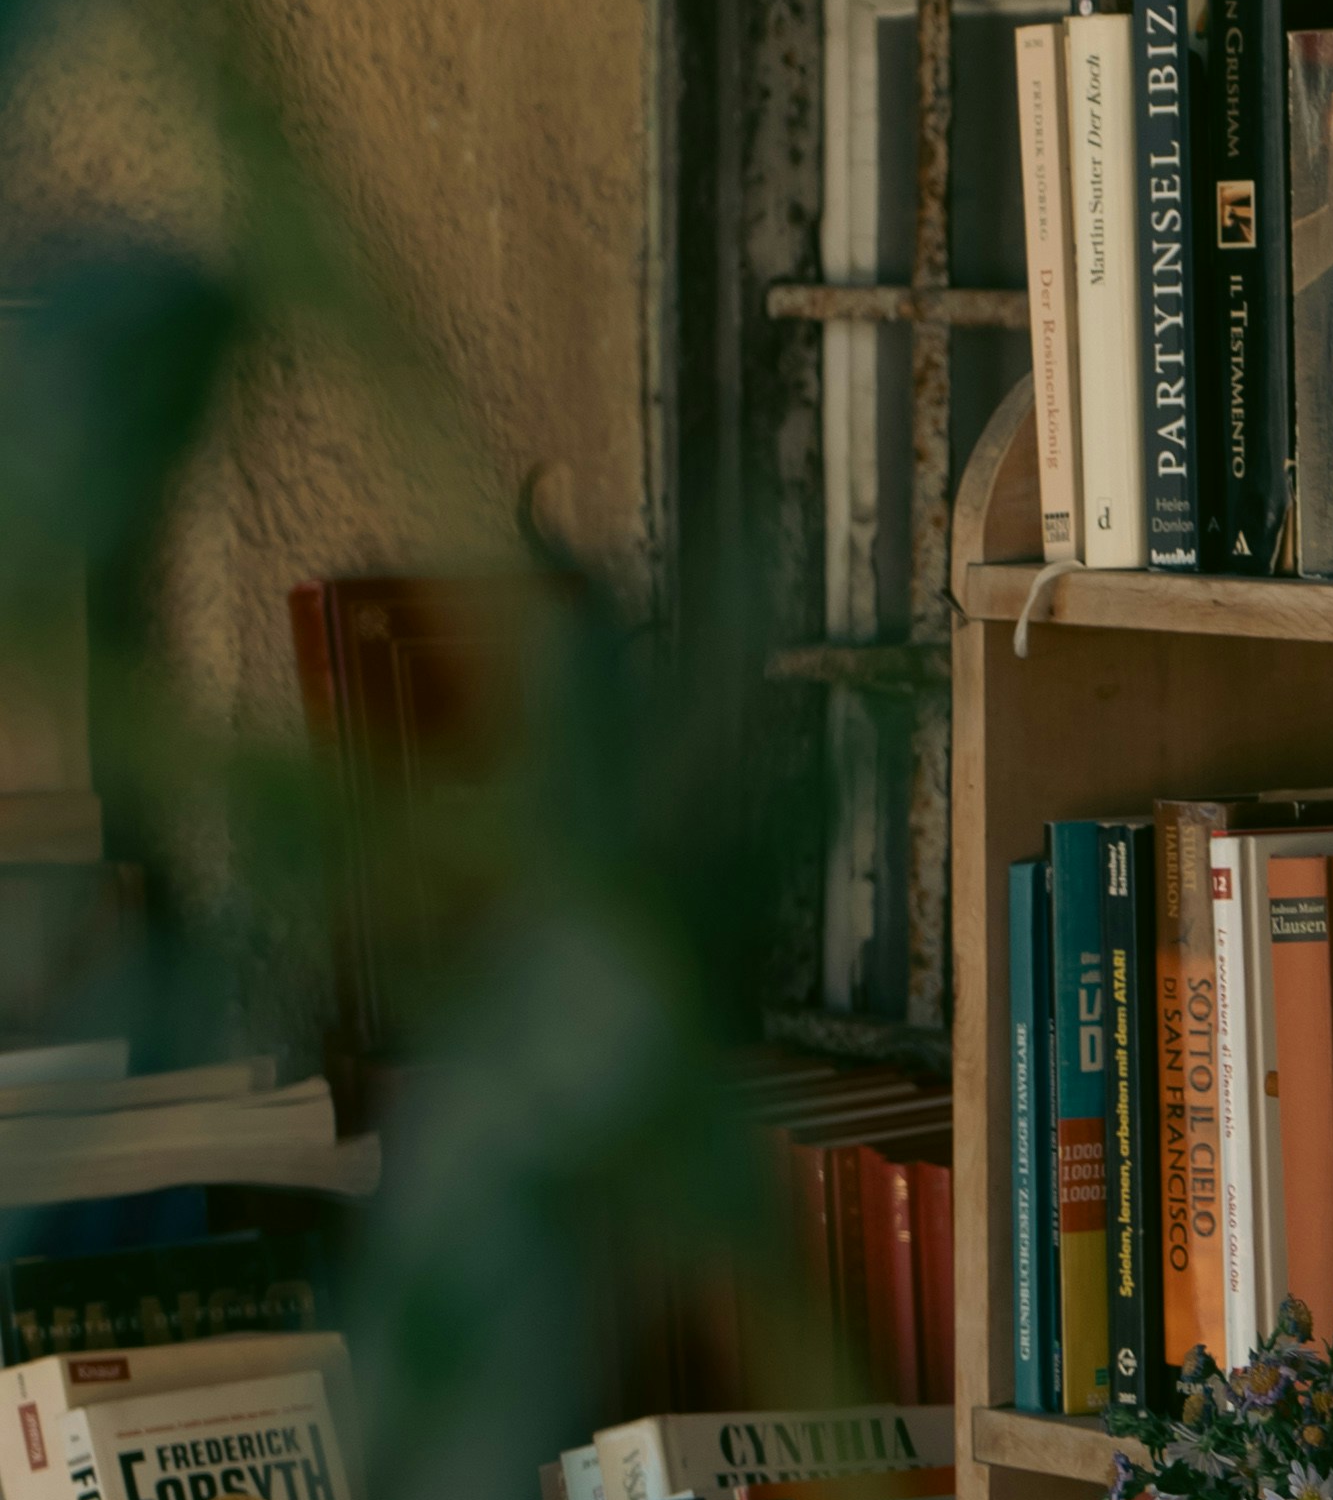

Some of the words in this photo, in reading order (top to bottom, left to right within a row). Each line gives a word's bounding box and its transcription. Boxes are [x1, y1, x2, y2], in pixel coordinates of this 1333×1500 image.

[1085, 53, 1102, 106] Koch
[1224, 27, 1244, 159] GRISHAM
[1087, 107, 1104, 150] Der
[1088, 153, 1105, 217] Suter
[1089, 220, 1106, 286] Martin
[1230, 274, 1244, 297] IL
[1040, 269, 1053, 306] Der
[1150, 139, 1188, 478] PARTYINSEL
[1042, 319, 1060, 470] Rosinenkönig
[1228, 302, 1249, 480] TESTAMENTO
[1166, 825, 1179, 919] HARRISON
[1182, 825, 1197, 891] STUART
[1272, 917, 1327, 935] Klausen
[1112, 949, 1127, 1005] ATARI
[1163, 976, 1177, 1000] DI
[1114, 1007, 1127, 1047] dem
[1164, 1008, 1184, 1075] SAN
[1187, 977, 1213, 1093] SOTTO
[1016, 1022, 1028, 1113] TAVOLARE
[1115, 1048, 1128, 1079] mit
[1017, 1116, 1029, 1176] LEGGE
[1116, 1080, 1130, 1158] arbeiten
[1189, 1104, 1215, 1133] IL
[1118, 1159, 1132, 1225] lernen,
[1165, 1085, 1189, 1272] FRANCISCO
[1190, 1142, 1217, 1238] CIELO
[1119, 1226, 1133, 1298] Spielen,
[155, 1425, 302, 1473] FREDERICK
[718, 1415, 919, 1469] CYNTHIA
